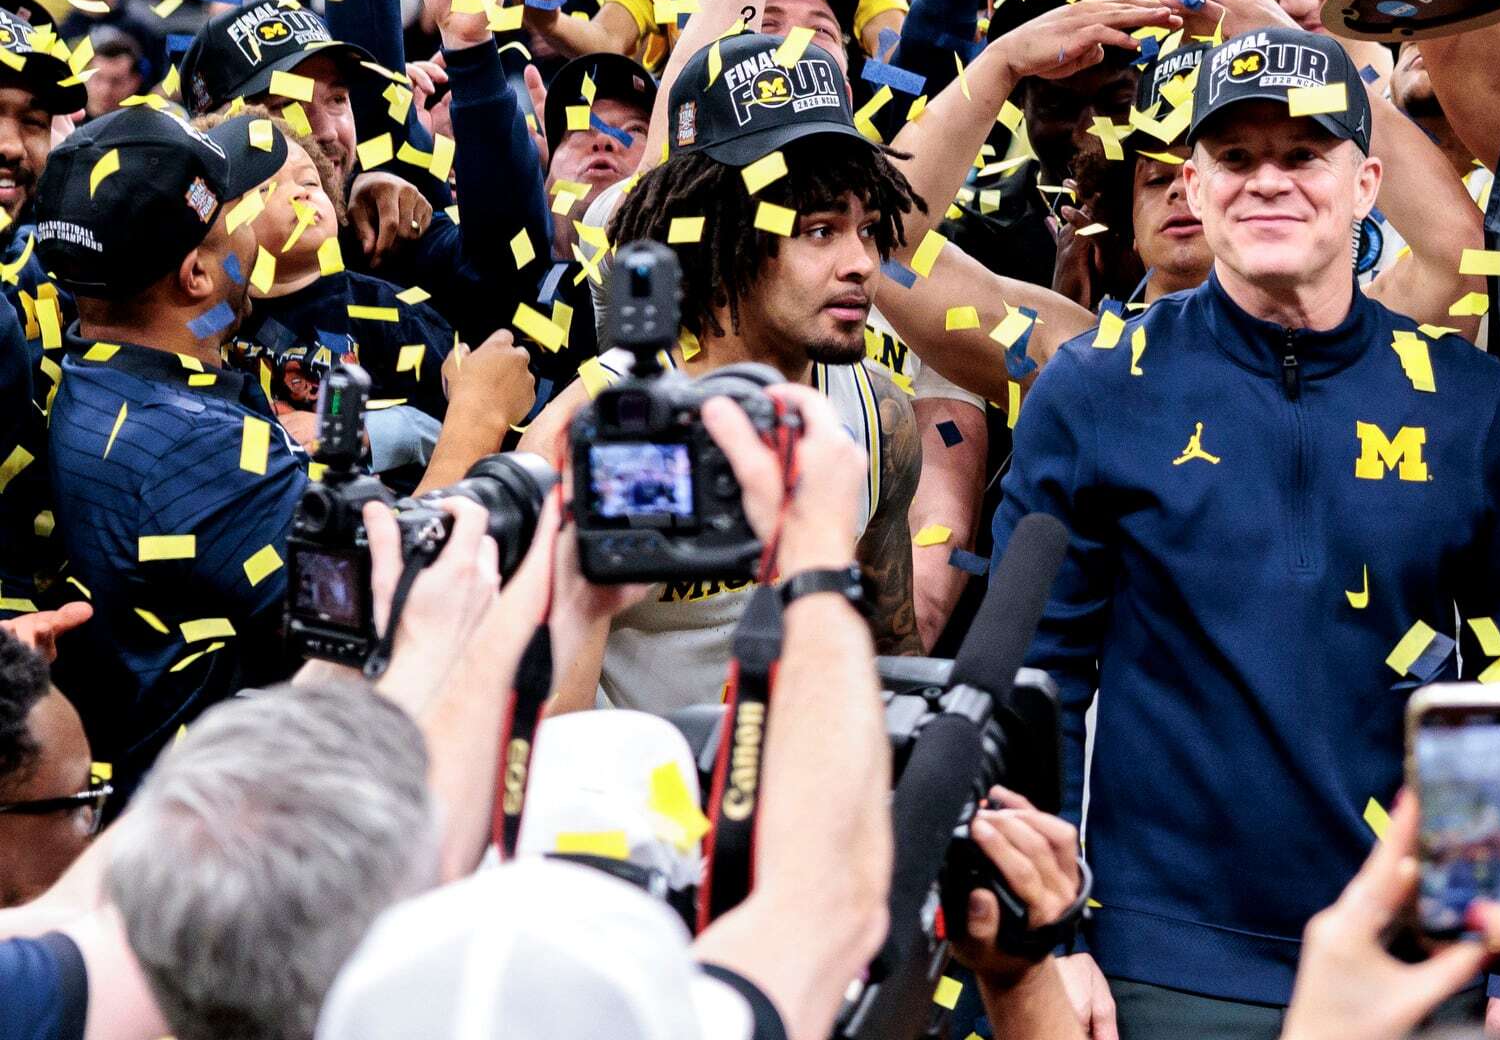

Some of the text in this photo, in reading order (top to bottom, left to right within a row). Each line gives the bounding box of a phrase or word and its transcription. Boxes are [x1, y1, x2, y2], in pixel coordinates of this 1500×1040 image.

[227, 2, 280, 42] FINAL
[1208, 44, 1328, 105] FOUR
[1211, 32, 1271, 73] FINAL
[1231, 55, 1260, 76] M
[757, 76, 788, 99] M
[1355, 420, 1428, 482] M
[503, 738, 530, 816] EOS
[722, 701, 765, 822] Canon
